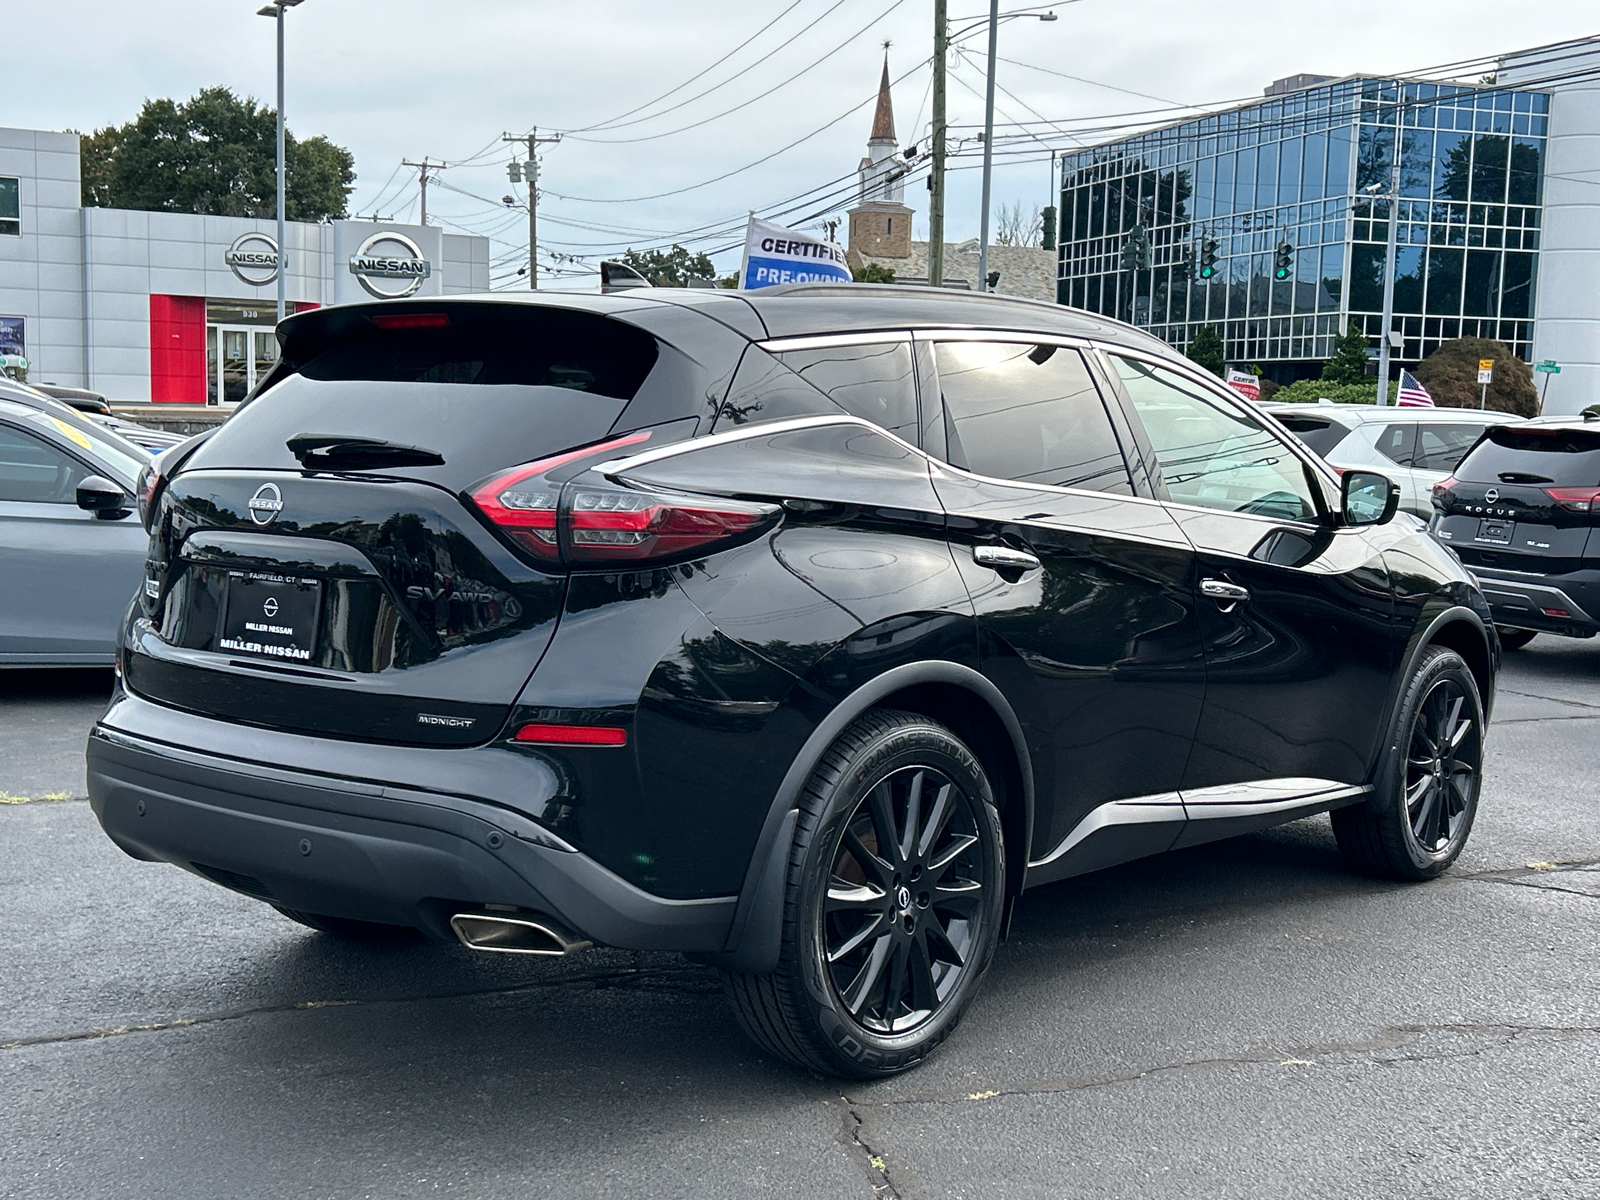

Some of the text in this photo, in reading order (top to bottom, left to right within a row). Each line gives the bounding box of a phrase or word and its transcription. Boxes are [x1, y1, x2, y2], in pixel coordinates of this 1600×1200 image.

[358, 259, 423, 273] NISSAN
[756, 267, 852, 284] PRE-OWNE
[1465, 505, 1516, 517] ROGUE
[249, 572, 284, 583] FAIRFIELD,
[406, 585, 494, 603] SV AWD
[245, 622, 293, 636] MILLER NISSAN
[220, 639, 310, 660] MILLER NISSAN
[418, 716, 473, 728] MIDNIGHT
